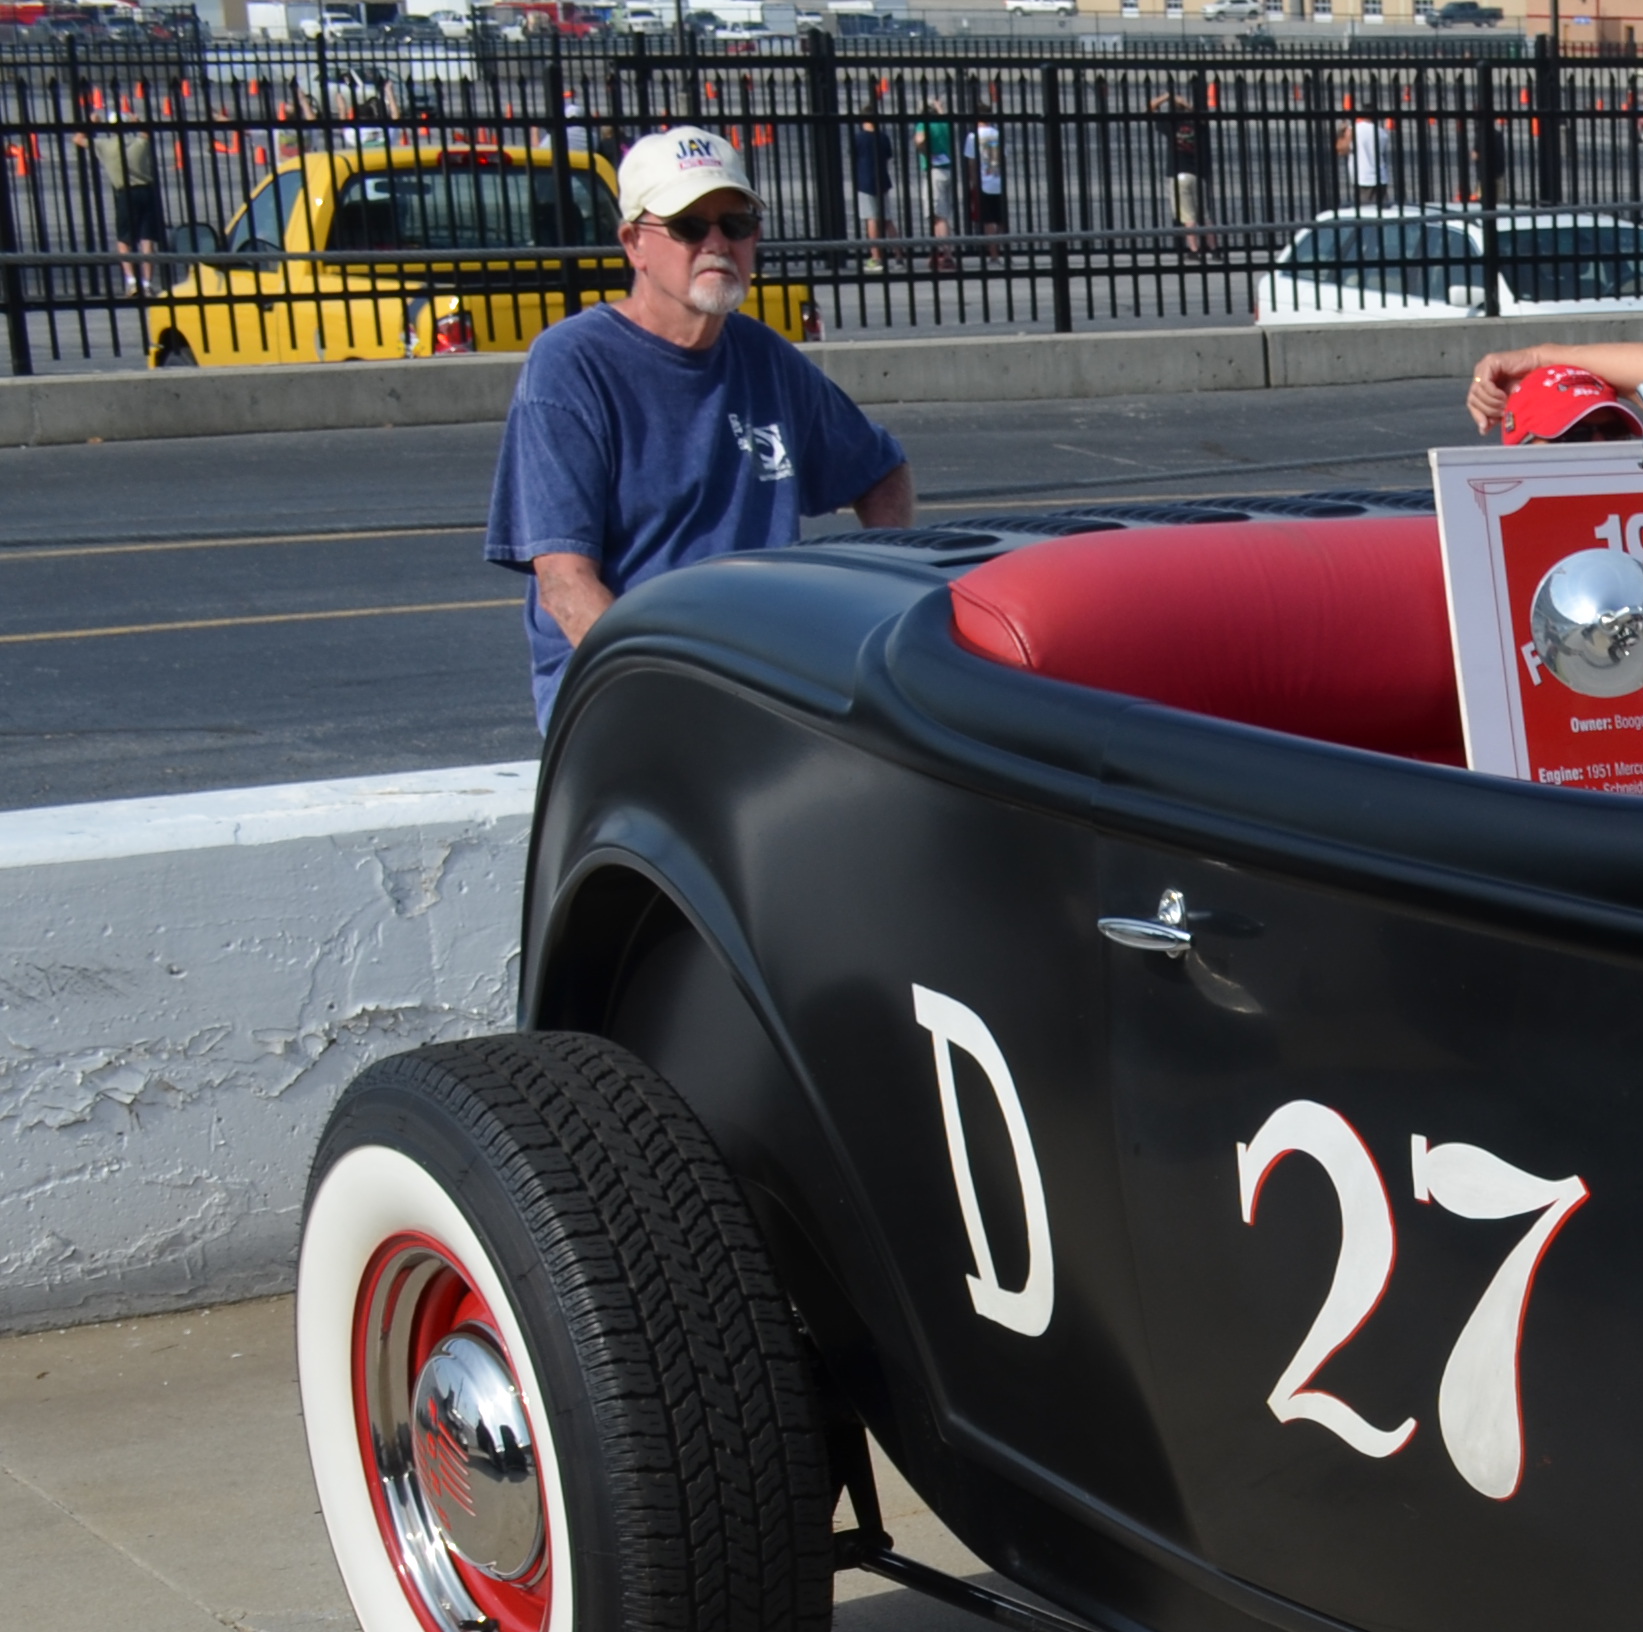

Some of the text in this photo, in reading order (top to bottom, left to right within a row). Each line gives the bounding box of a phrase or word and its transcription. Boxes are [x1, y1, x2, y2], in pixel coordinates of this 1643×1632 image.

[676, 138, 711, 159] JAY
[1570, 717, 1613, 733] Owner:
[1538, 767, 1584, 786] Engine:
[1586, 764, 1612, 779] 1951
[911, 982, 1055, 1337] D
[1235, 1098, 1590, 1501] 27
